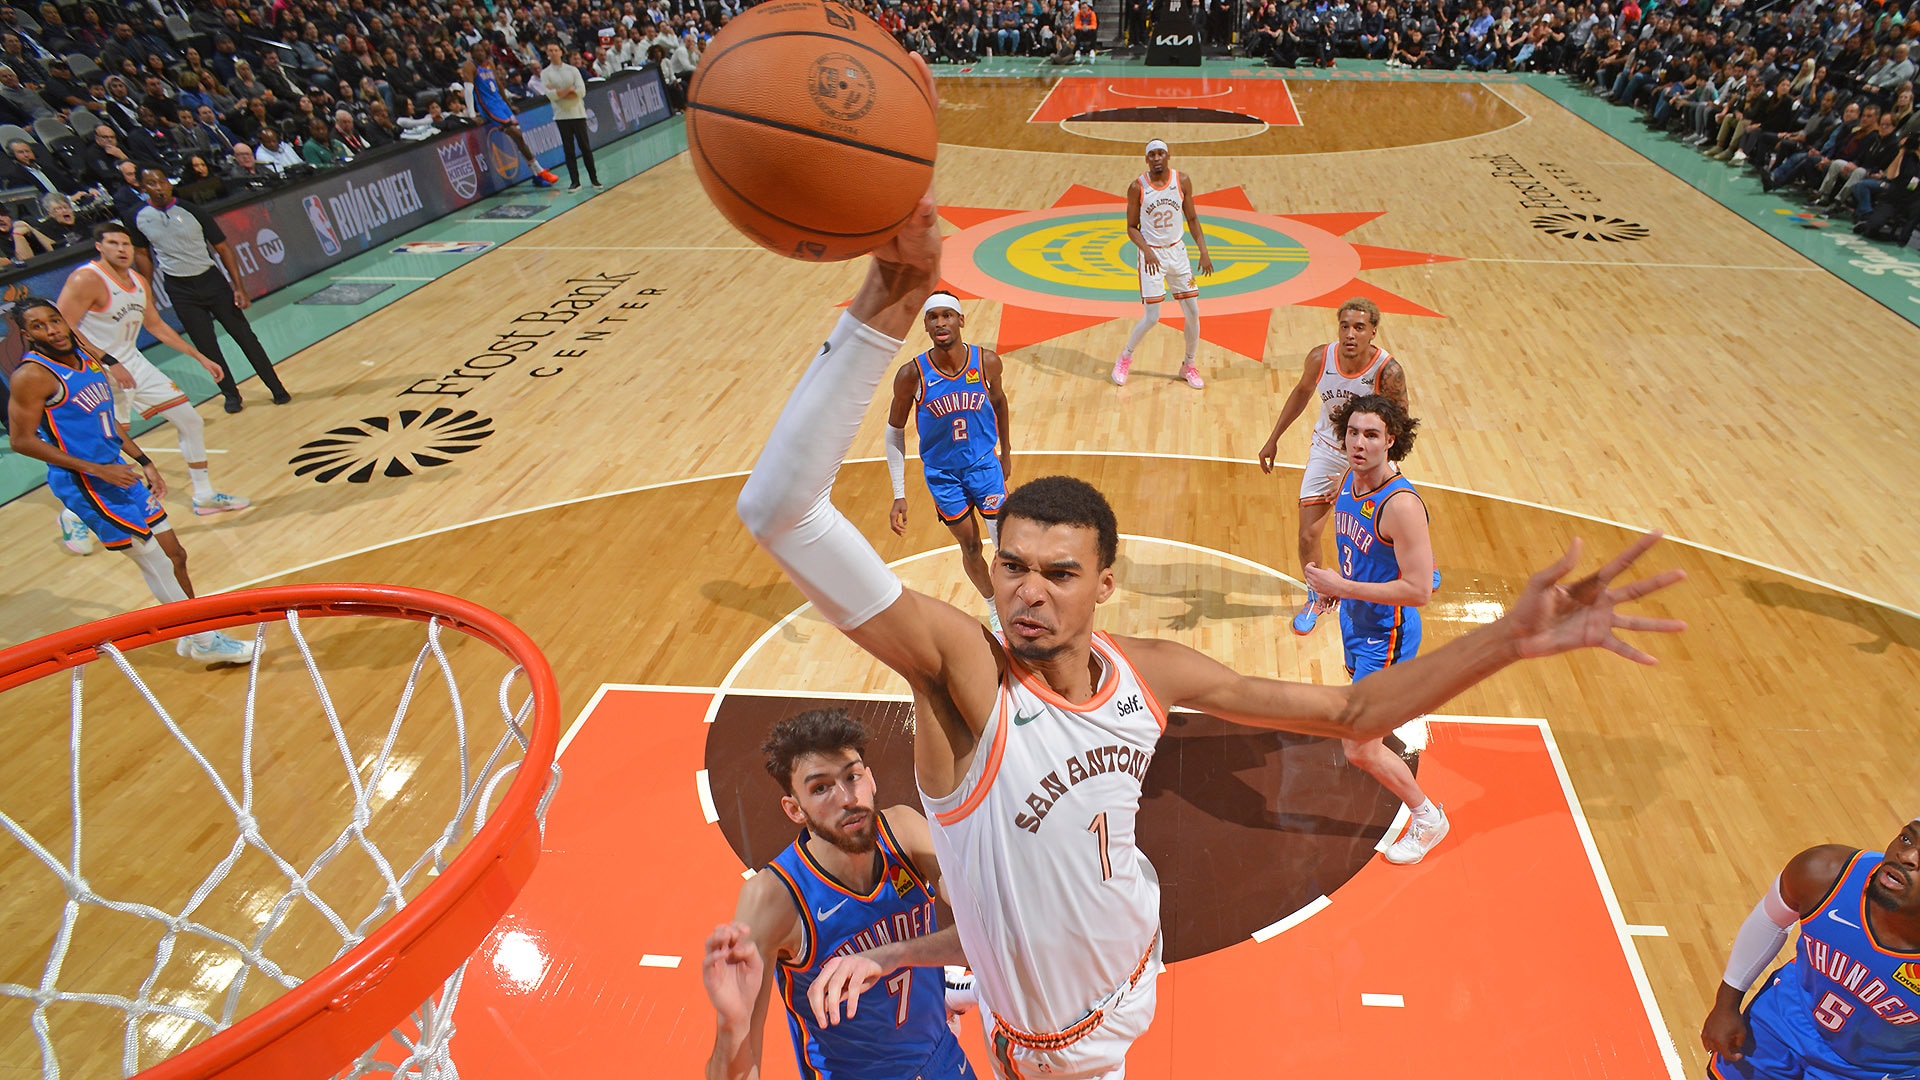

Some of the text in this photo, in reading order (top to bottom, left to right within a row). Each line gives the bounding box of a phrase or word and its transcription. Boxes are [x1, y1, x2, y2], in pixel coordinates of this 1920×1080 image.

[1156, 35, 1193, 46] KIA
[641, 80, 665, 114] WEEK
[329, 169, 424, 241] RIVALS WEEK
[1153, 209, 1174, 229] 22
[125, 320, 140, 341] 17
[396, 270, 640, 399] Frost Bank
[529, 287, 668, 378] CENTER
[926, 391, 987, 418] THUNDER
[952, 417, 968, 442] 2
[1334, 511, 1374, 555] HUNDER
[1342, 543, 1353, 578] 3
[1117, 694, 1143, 717] Self.
[1014, 770, 1069, 834] SAN
[1087, 811, 1112, 881] 1
[886, 966, 913, 1029] 7
[1801, 932, 1920, 1026] THUNDER
[1812, 990, 1856, 1033] 5
